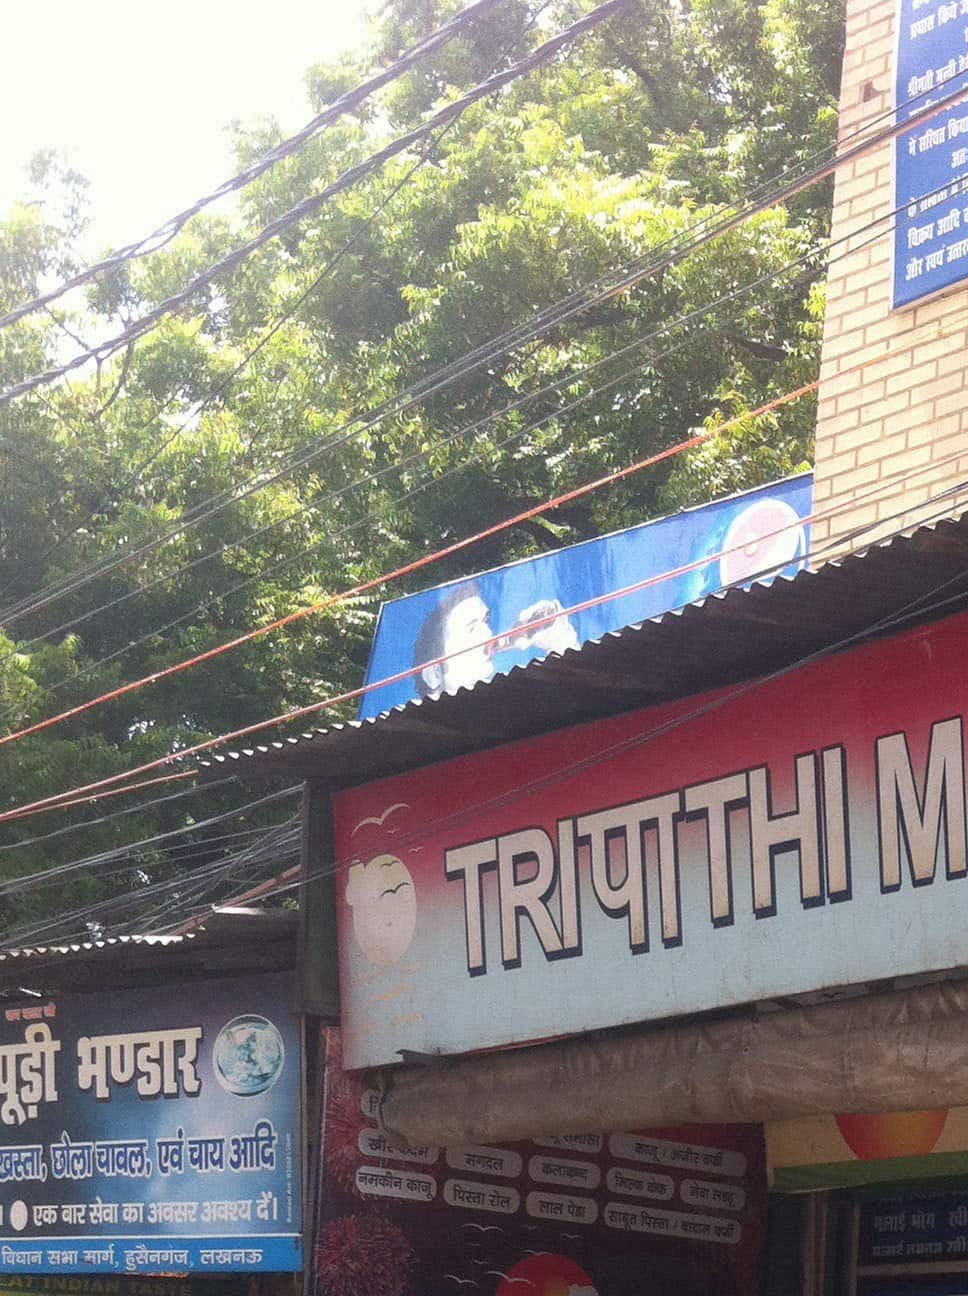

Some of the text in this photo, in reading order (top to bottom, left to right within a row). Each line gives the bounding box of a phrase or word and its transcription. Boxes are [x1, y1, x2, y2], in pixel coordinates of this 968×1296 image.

[77, 1027, 202, 1099] भण्डार
[157, 1127, 185, 1175] एवं
[187, 1136, 225, 1174] चाय
[228, 1118, 277, 1176] आदि
[358, 1171, 402, 1189] नमकीन
[33, 1203, 58, 1225] एक
[61, 1202, 86, 1225] बार
[89, 1196, 119, 1224] सेवा
[122, 1202, 144, 1224] का
[147, 1202, 197, 1223] अवसर
[201, 1200, 252, 1223] अवश्य
[488, 1190, 511, 1208] रोल
[47, 1249, 78, 1265] सभा
[199, 1247, 263, 1265] लखनऊ
